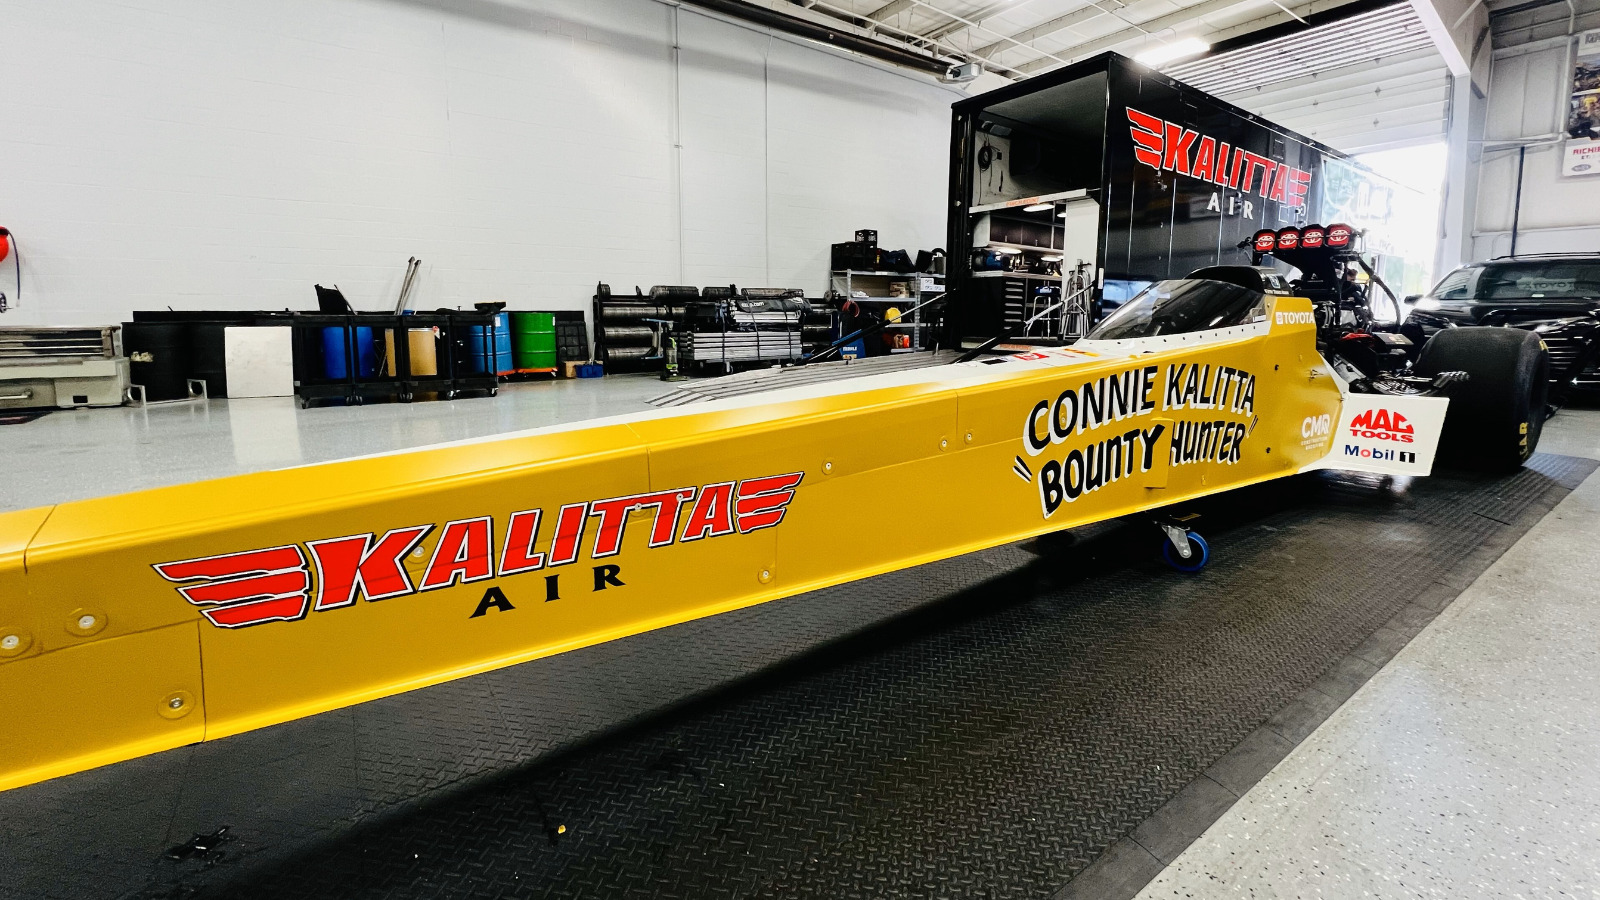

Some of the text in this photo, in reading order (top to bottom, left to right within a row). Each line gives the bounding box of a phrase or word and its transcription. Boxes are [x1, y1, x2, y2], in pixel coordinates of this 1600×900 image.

[1163, 121, 1289, 203] KALITTA
[1207, 192, 1253, 219] AIR
[1283, 312, 1316, 324] TOYOTA
[1023, 363, 1256, 456] CONNIE KALITTA
[1350, 409, 1414, 434] MAC
[1350, 429, 1414, 443] TOOLS
[1345, 444, 1394, 461] Mobil
[307, 481, 737, 610] KALITTA
[469, 564, 626, 618] AIR
